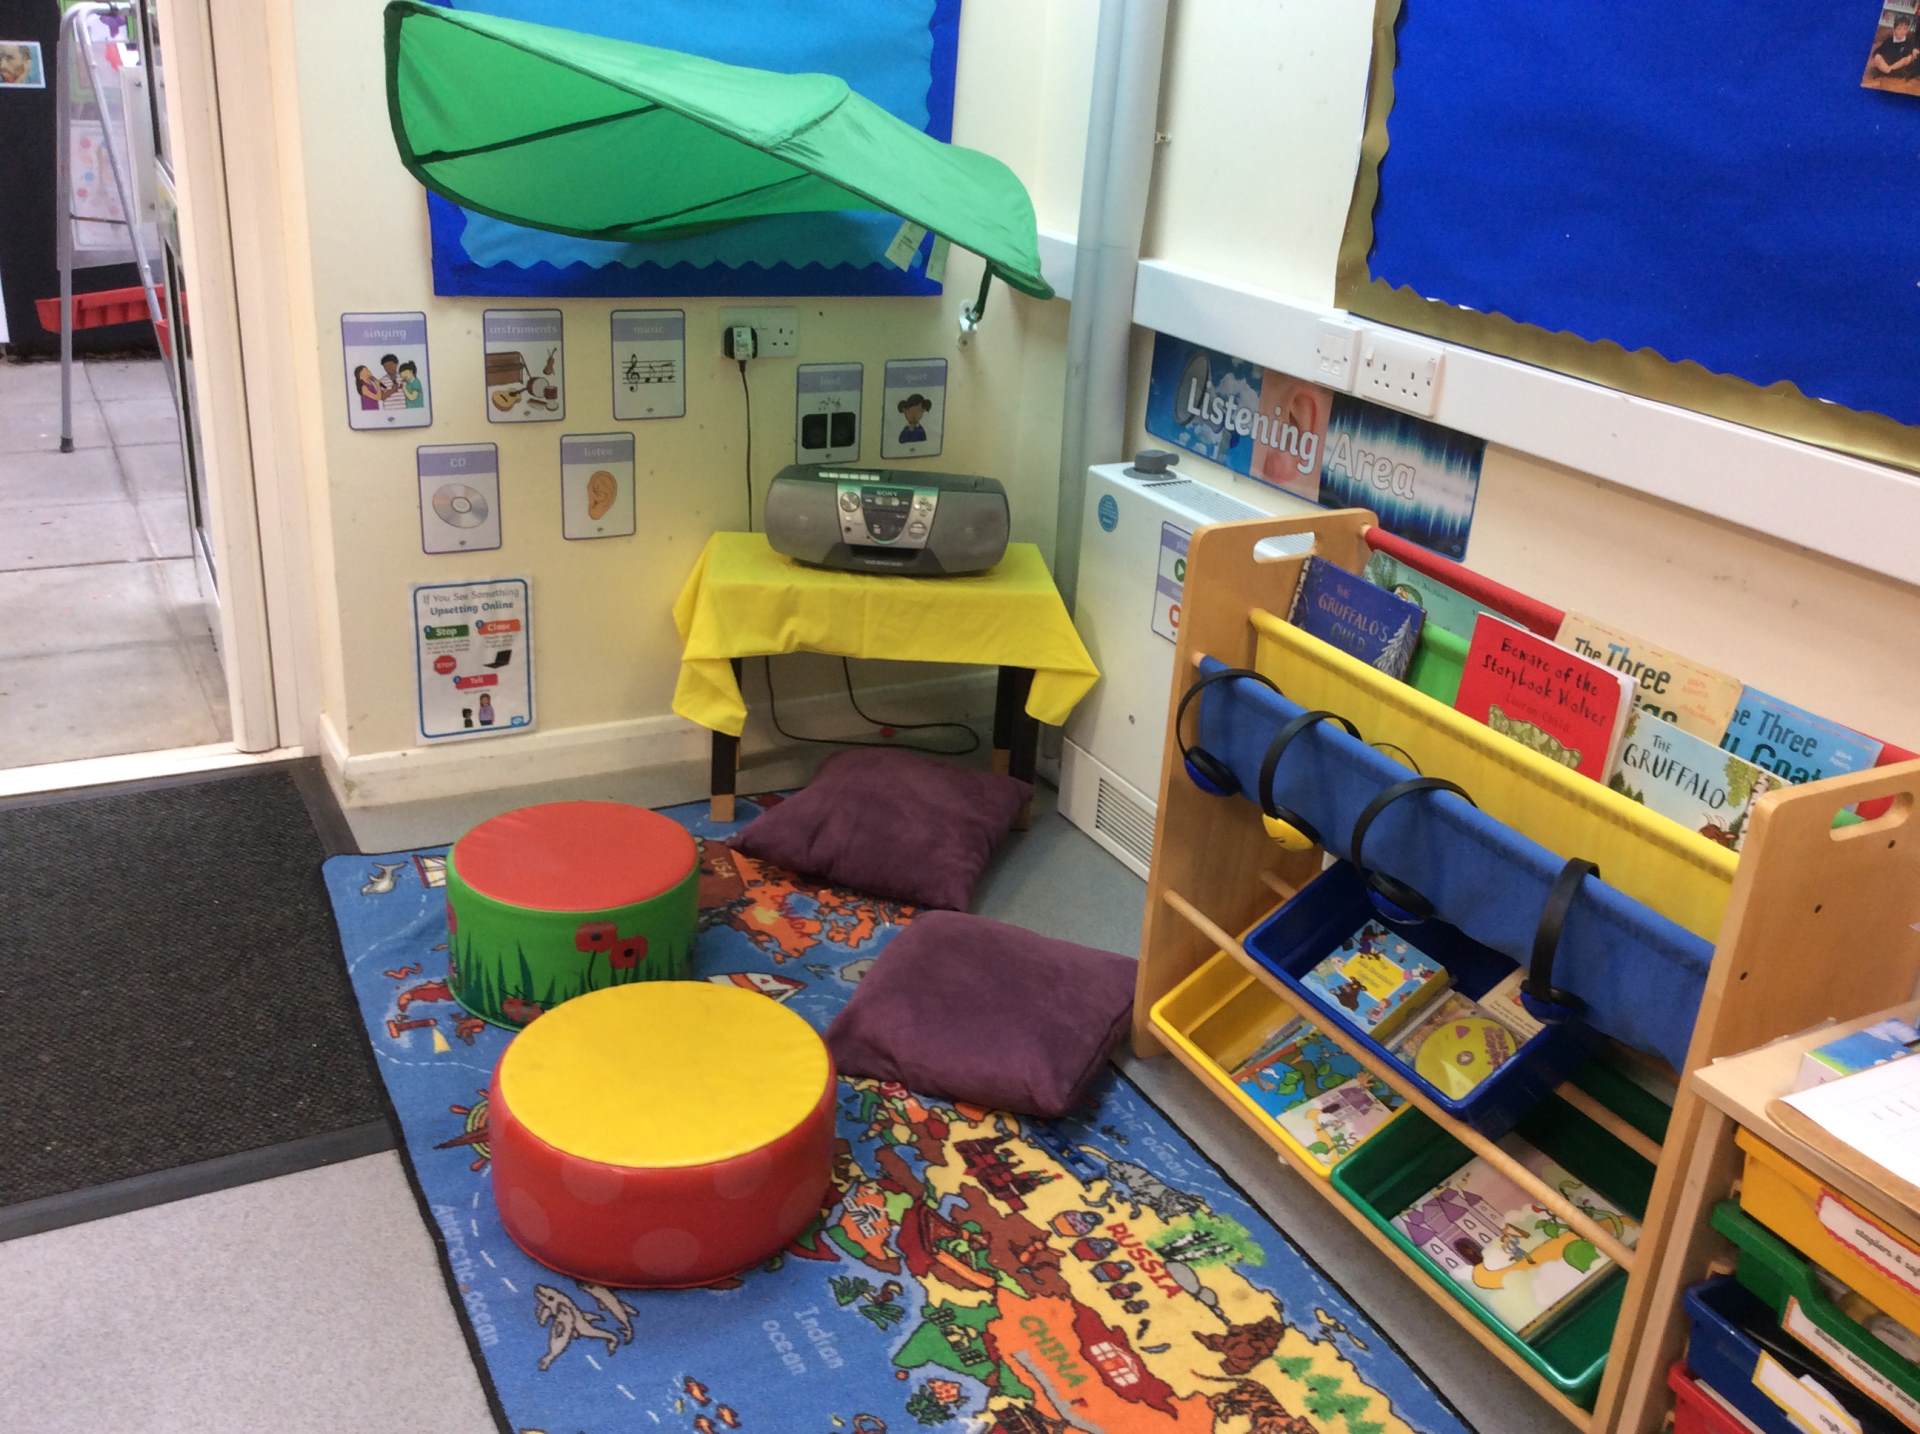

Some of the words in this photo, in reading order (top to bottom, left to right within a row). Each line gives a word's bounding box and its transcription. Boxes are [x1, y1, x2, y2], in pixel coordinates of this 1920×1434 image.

[363, 328, 407, 342] singing
[449, 457, 467, 469] CD
[1186, 377, 1319, 474] Listening
[1328, 432, 1416, 500] Area
[430, 604, 478, 617] Upsetting
[481, 601, 514, 612] Online
[433, 592, 450, 602] You
[471, 588, 519, 599] Something
[436, 627, 458, 638] Stop
[1483, 654, 1552, 697] Storybook
[1500, 637, 1550, 673] Beware
[1555, 667, 1574, 683] of
[1576, 671, 1598, 696] the
[1575, 637, 1602, 661] The
[1606, 642, 1672, 695] Three
[1652, 734, 1673, 753] THE
[1757, 709, 1818, 758] Three
[1622, 743, 1727, 811] GRUFFALO
[1106, 1220, 1183, 1300] RUSSIA
[465, 1290, 499, 1348] ocean
[762, 1317, 807, 1377] ocean
[791, 1305, 846, 1370] Indian
[1019, 1315, 1089, 1389] CHINA
